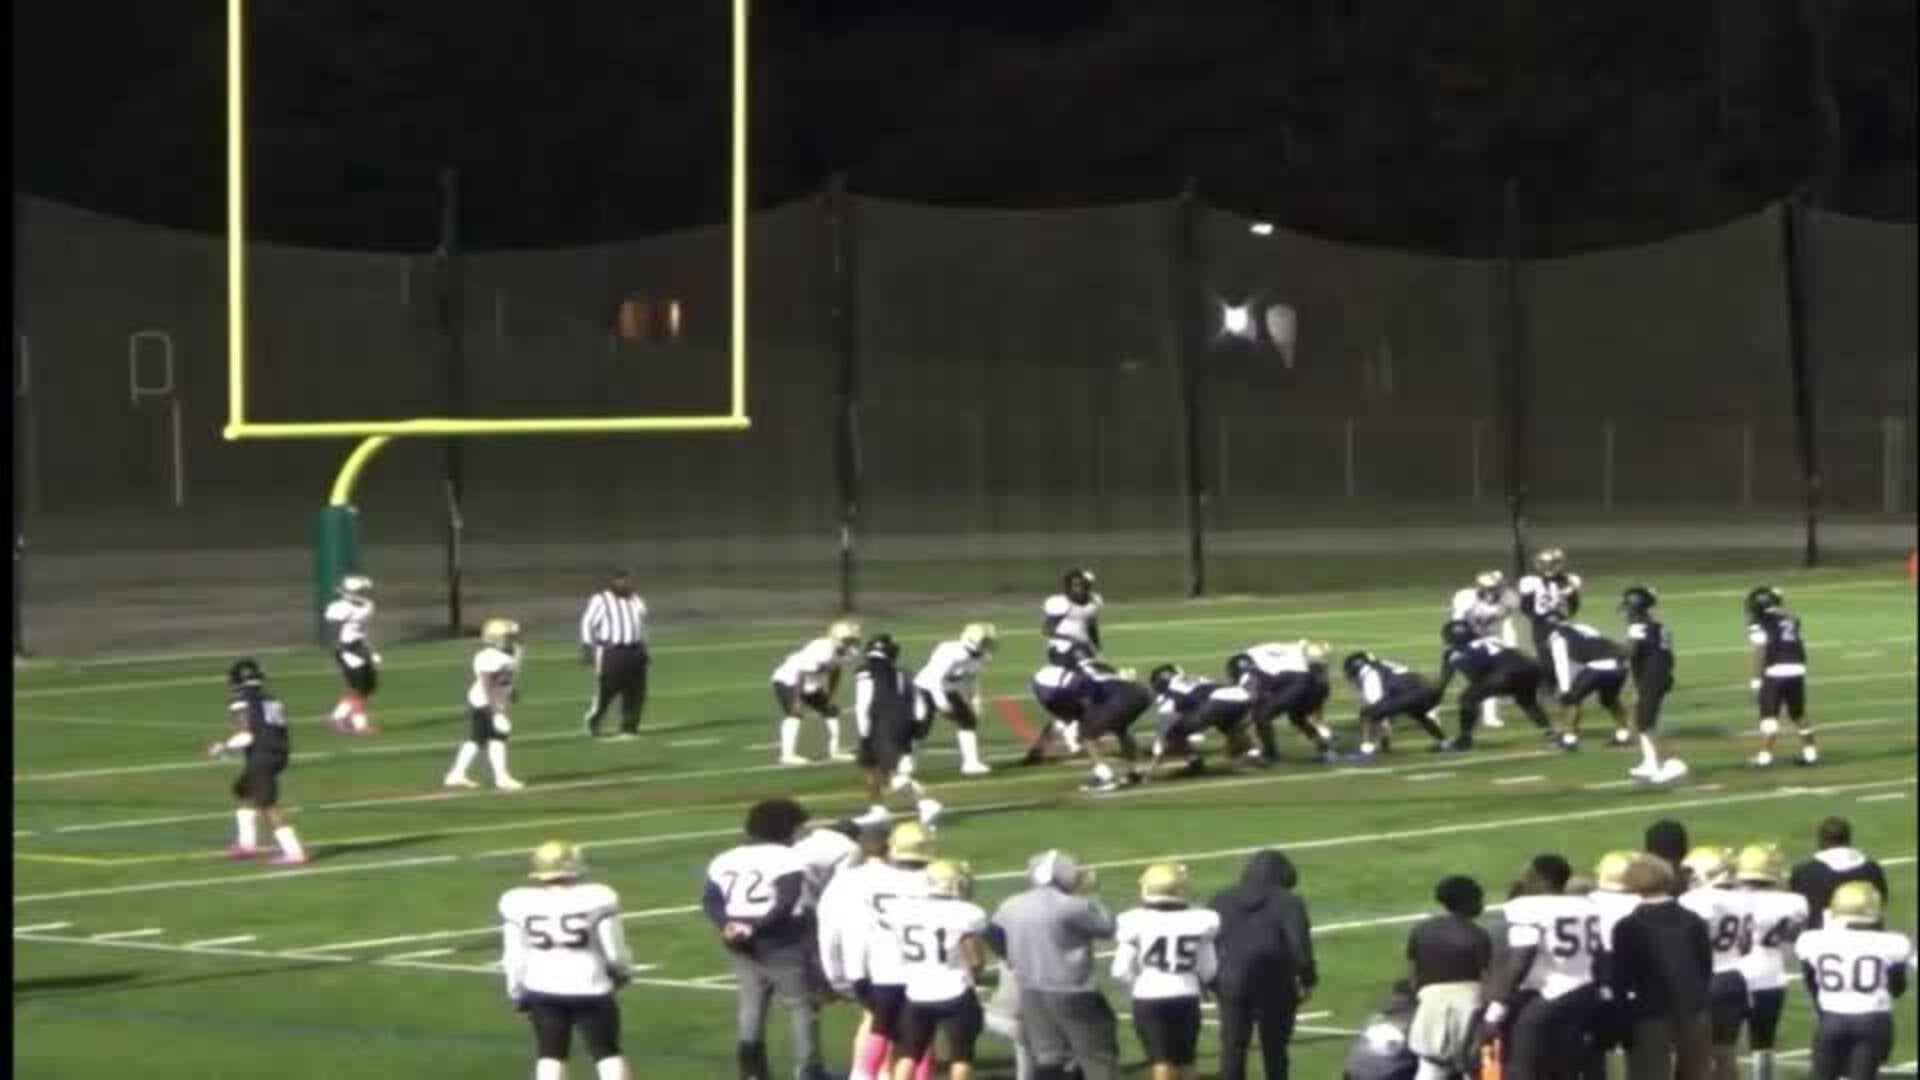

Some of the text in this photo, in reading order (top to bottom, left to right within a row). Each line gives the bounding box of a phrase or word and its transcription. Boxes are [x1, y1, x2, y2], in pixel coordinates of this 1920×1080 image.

[722, 870, 769, 904] 72
[525, 914, 590, 949] 55
[902, 924, 947, 964] 51
[1143, 934, 1203, 973] 45
[1817, 953, 1880, 994] 60
